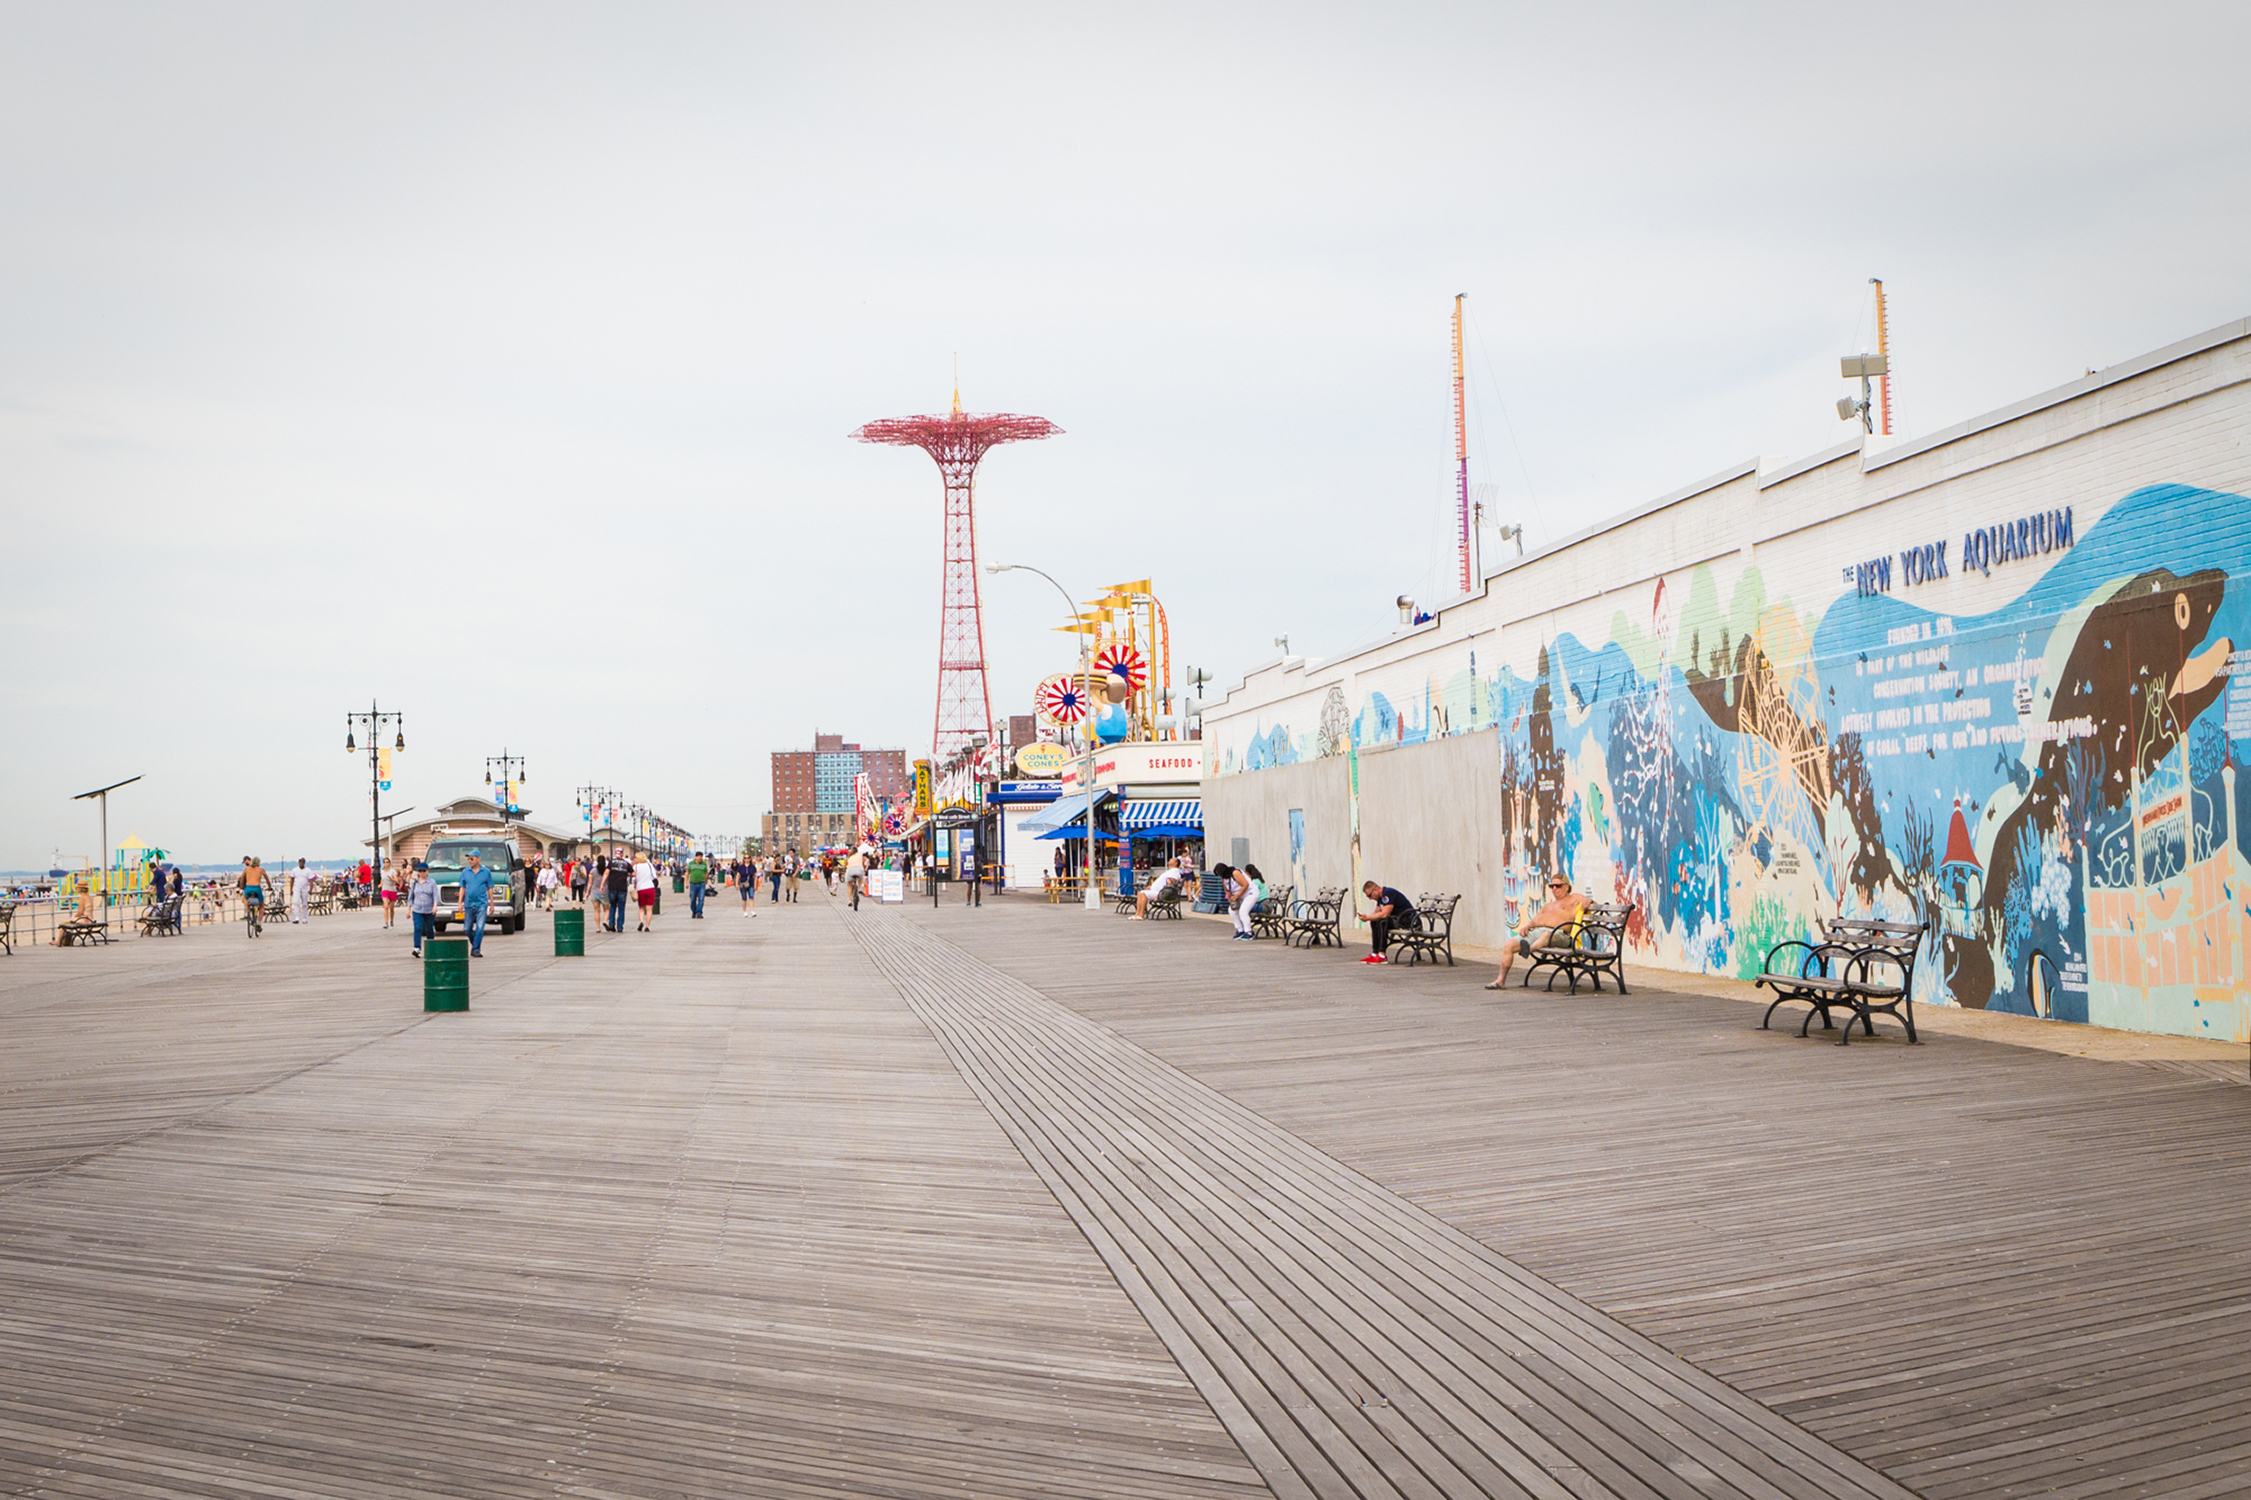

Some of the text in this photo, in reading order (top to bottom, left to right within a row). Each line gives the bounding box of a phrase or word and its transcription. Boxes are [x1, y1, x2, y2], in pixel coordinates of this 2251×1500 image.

[1842, 506, 2074, 598] THE NEW YORK AQUARIUM
[1899, 652, 1912, 669] THE
[1873, 676, 1925, 699] CONSERVATION
[1966, 667, 1978, 687] AN
[1984, 656, 2048, 685] ORGANIZATION
[1876, 707, 1910, 730] INVOLVED
[1913, 705, 1922, 725] IN
[1924, 703, 1939, 724] THE
[1942, 697, 1991, 723] PROTECTION
[1866, 740, 1874, 757] OF
[1876, 738, 1900, 757] CORAL
[1932, 732, 1948, 751] FOR
[1952, 730, 1968, 750] OUR
[1023, 753, 1063, 761] CONEY'S
[1027, 760, 1059, 768] CONES
[1149, 758, 1193, 769] SEAFOOD
